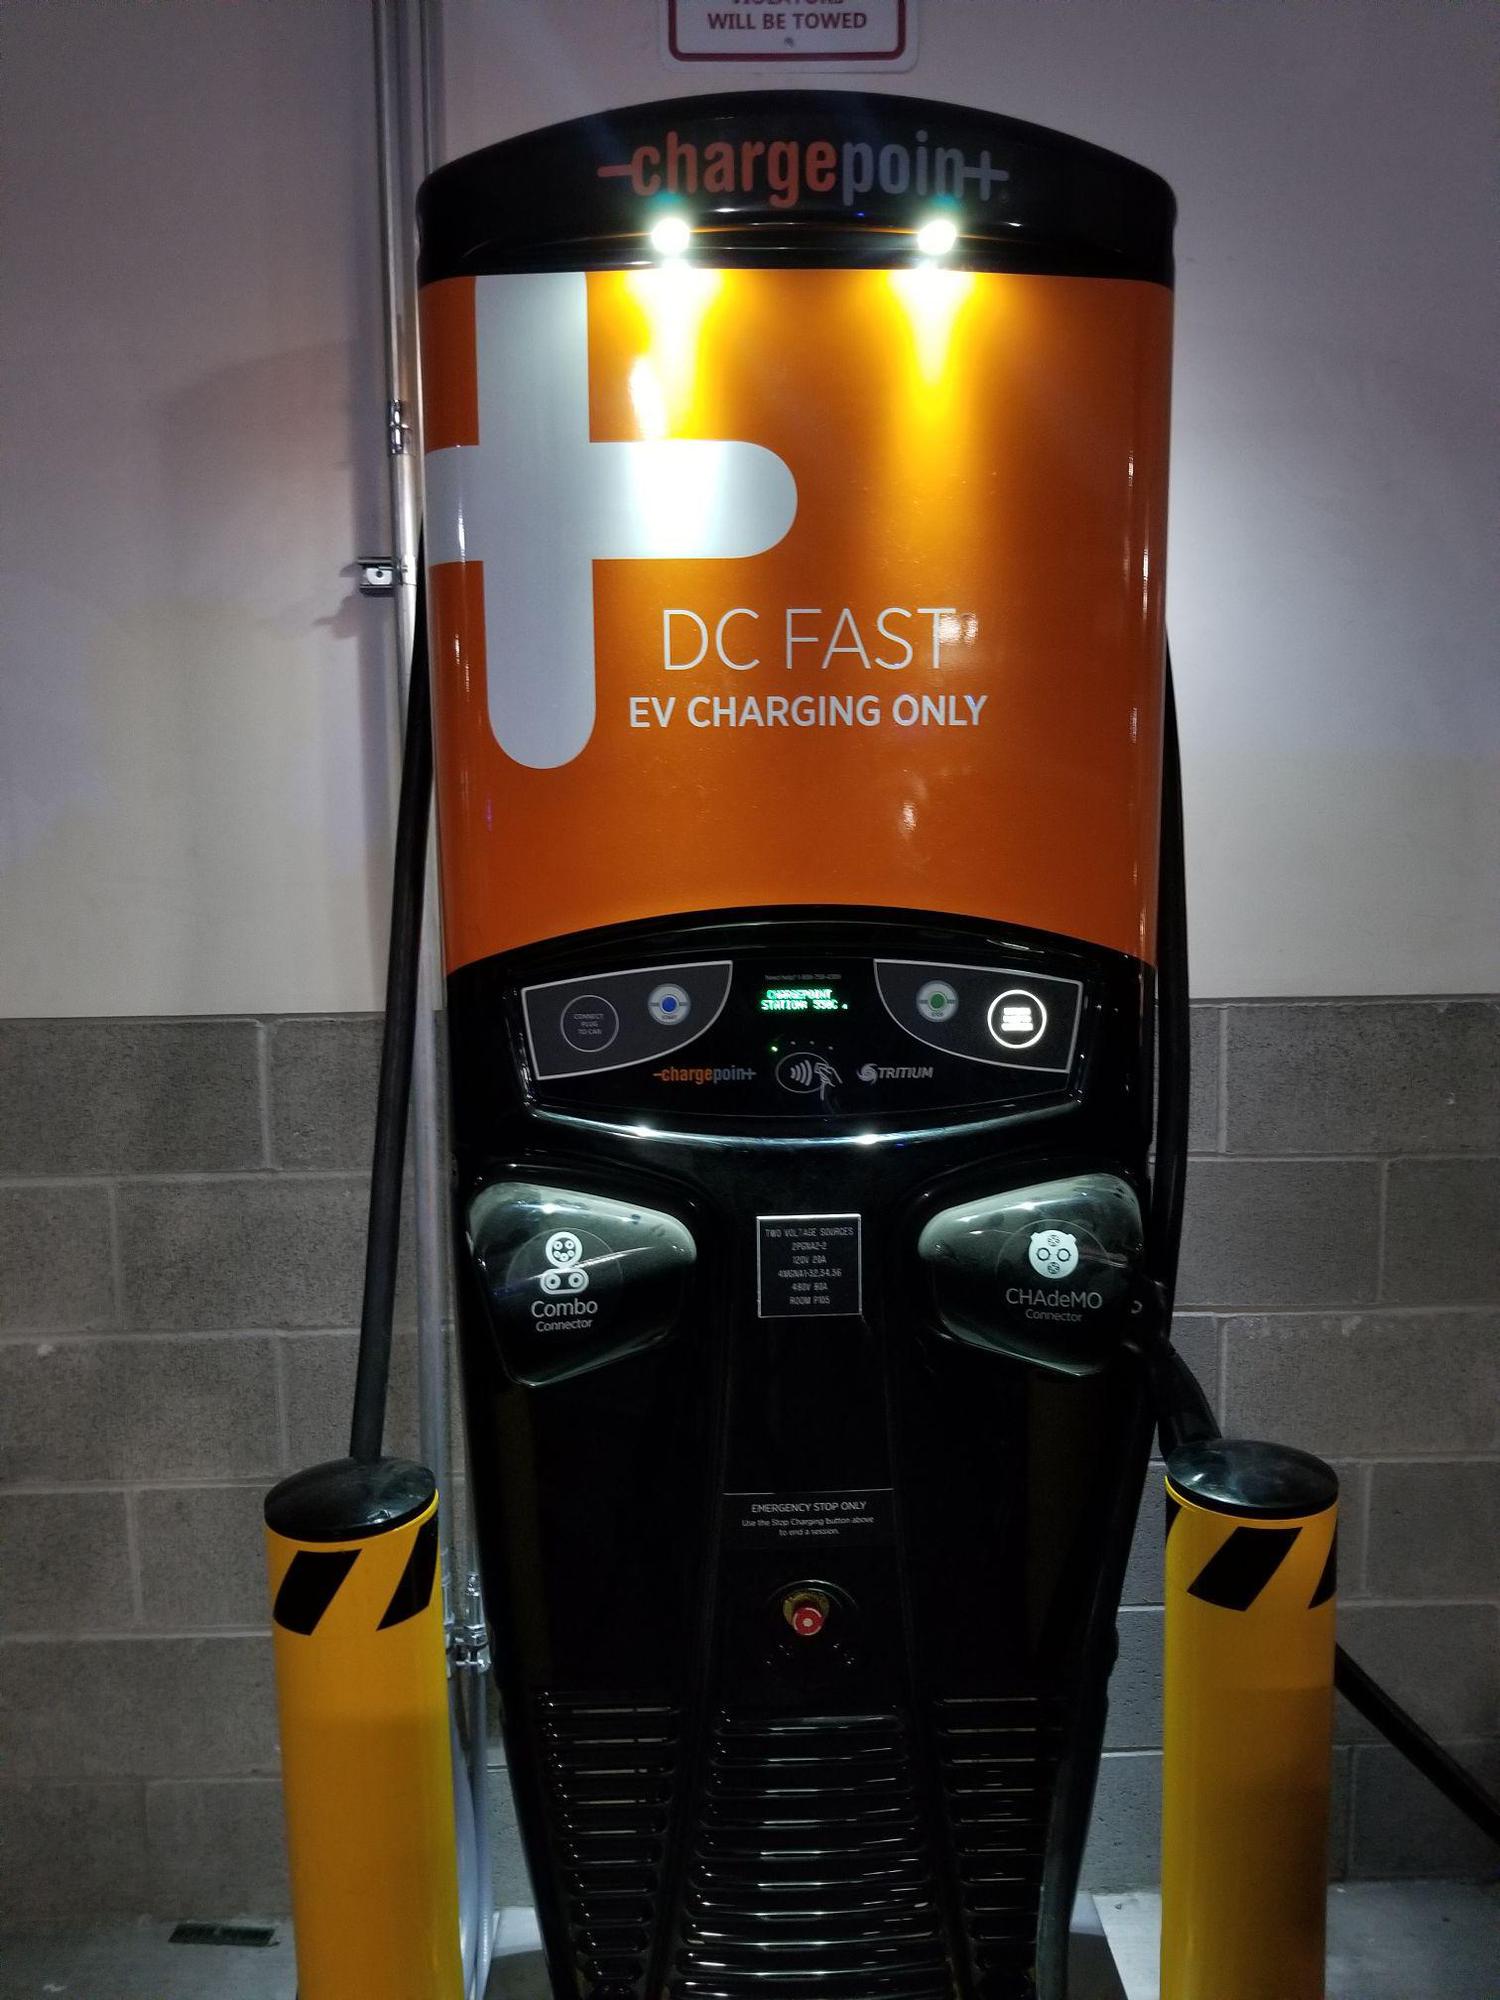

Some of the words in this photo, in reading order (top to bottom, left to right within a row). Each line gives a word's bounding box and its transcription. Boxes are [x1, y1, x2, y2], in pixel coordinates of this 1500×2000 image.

[708, 13, 757, 30] WILL
[763, 13, 786, 30] BE
[793, 12, 868, 30] TOWED
[663, 608, 760, 670] DC
[784, 607, 957, 670] FAST
[629, 696, 677, 728] EV
[687, 695, 881, 728] CHARGING
[892, 694, 989, 727] ONLY
[878, 1066, 934, 1080] TRITIUM
[765, 1229, 782, 1238] TWO
[785, 1227, 817, 1237] VOLTAGE
[820, 1226, 855, 1237] SOURCES
[789, 1296, 812, 1305] ROOM
[1005, 1288, 1103, 1309] CHAdeMO
[531, 1298, 598, 1319] Combo
[1025, 1308, 1083, 1322] Connector
[535, 1319, 593, 1332] Connector
[751, 1503, 812, 1513] EMERGENCY
[813, 1502, 839, 1512] STOP
[840, 1501, 867, 1511] ONLY
[757, 1519, 771, 1527] the
[771, 1518, 788, 1528] Stop
[790, 1518, 824, 1527] Charging
[825, 1517, 850, 1525] button
